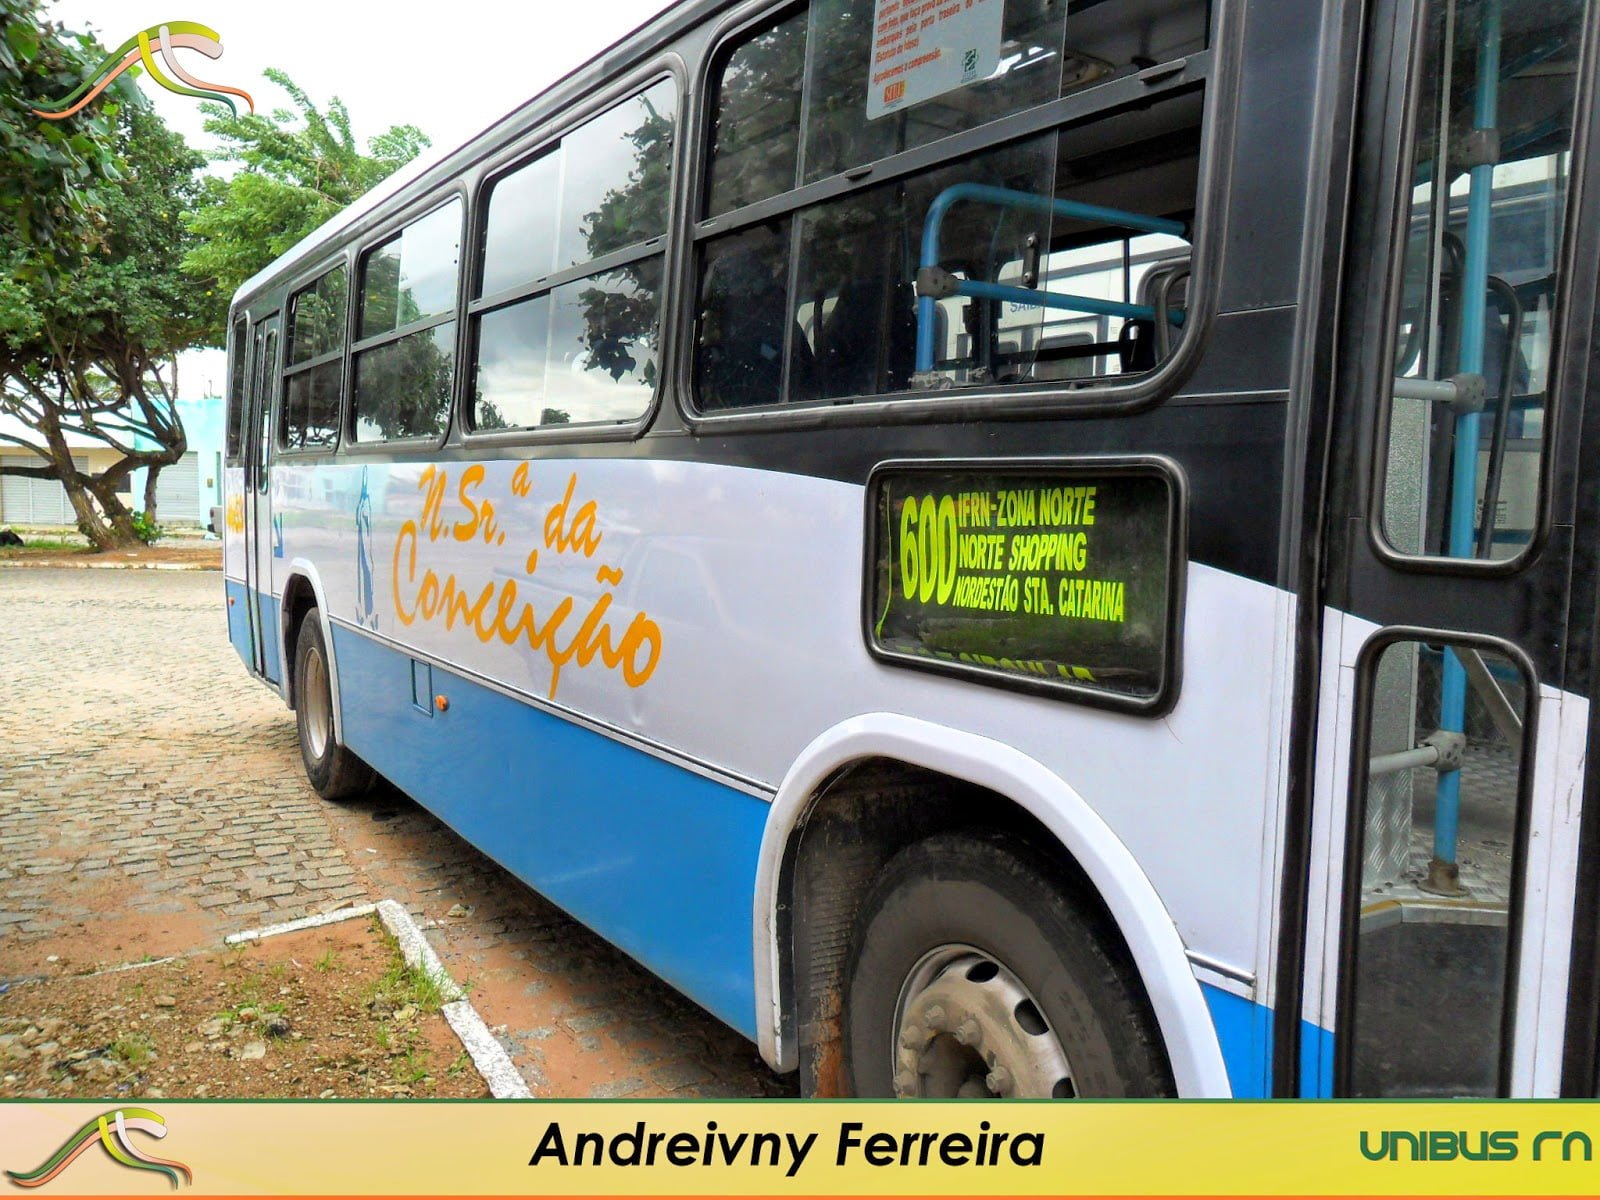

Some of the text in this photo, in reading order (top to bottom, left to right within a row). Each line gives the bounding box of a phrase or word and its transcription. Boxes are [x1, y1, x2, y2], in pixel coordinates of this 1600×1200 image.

[544, 472, 602, 558] da
[1038, 486, 1097, 526] NORTE
[899, 494, 957, 605] 600
[958, 532, 1087, 571] NORTE SHOPPING
[392, 520, 662, 700] Conceição
[1023, 576, 1054, 615] STA.
[1058, 578, 1125, 623] CATARINA
